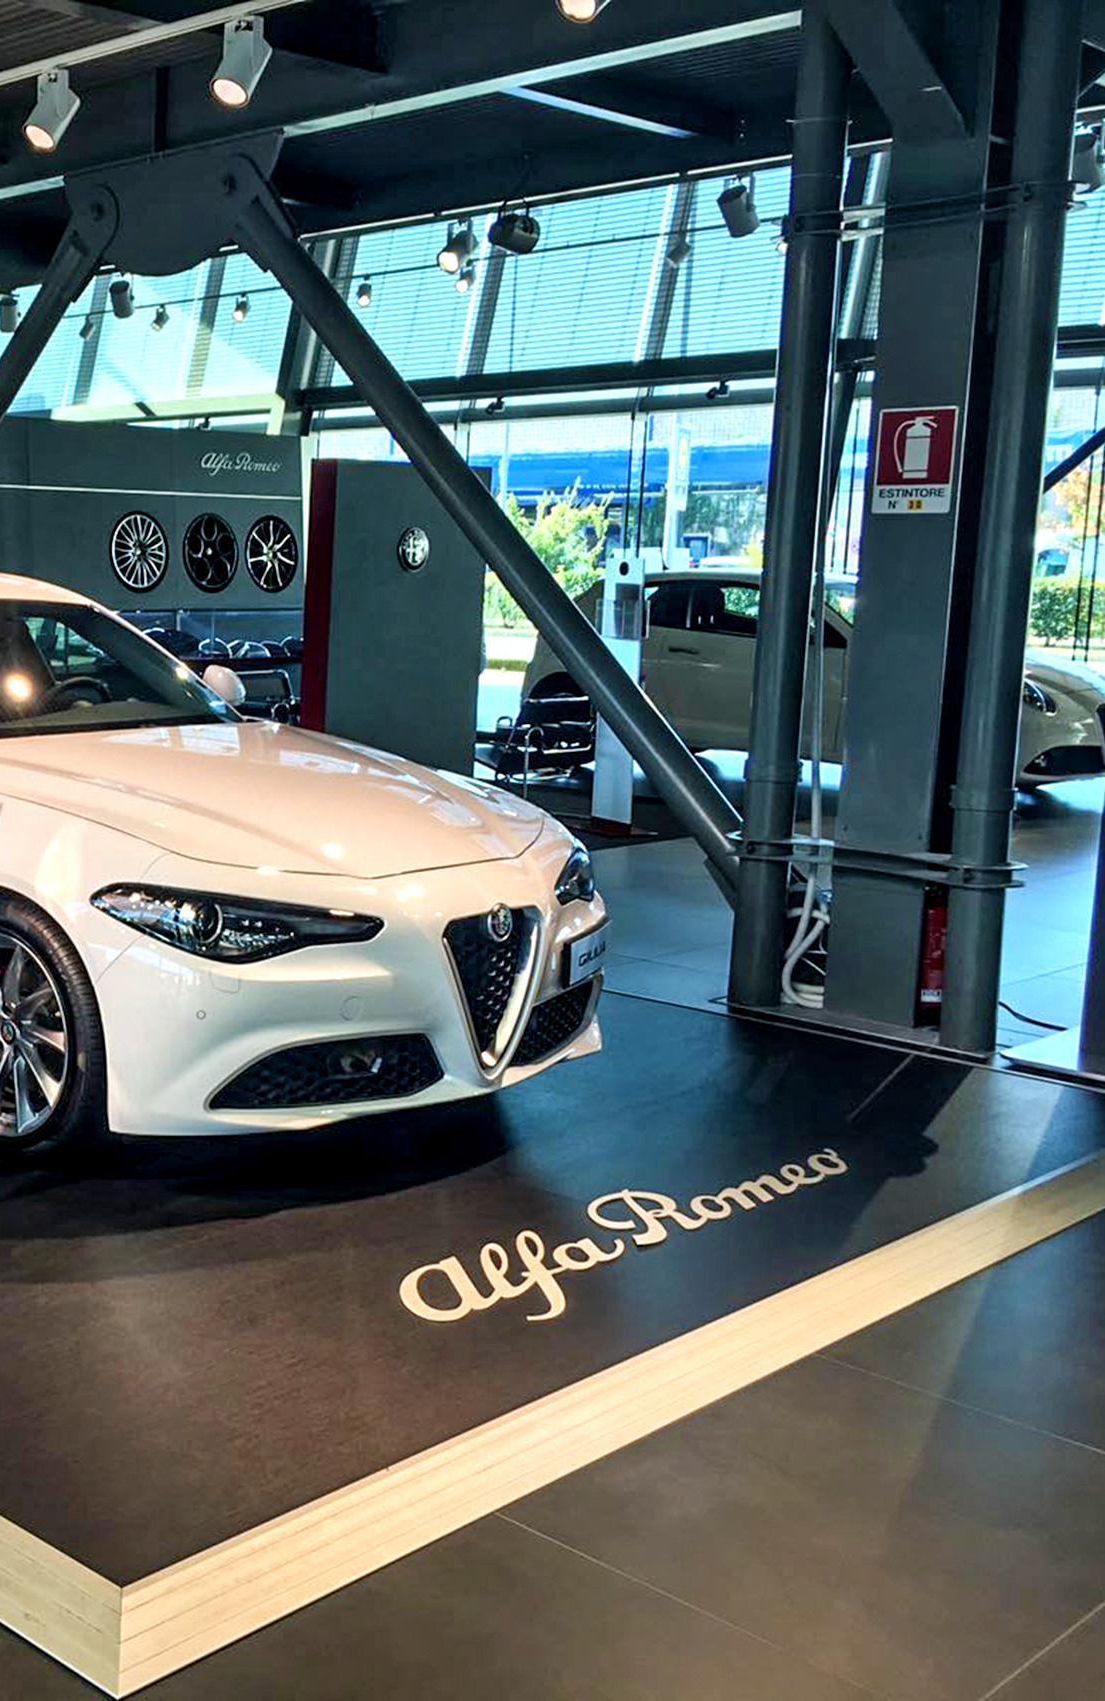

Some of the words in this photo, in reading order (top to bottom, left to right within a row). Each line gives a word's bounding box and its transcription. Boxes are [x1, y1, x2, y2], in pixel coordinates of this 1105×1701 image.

[200, 452, 233, 476] Alfa
[234, 452, 281, 472] Romeo
[878, 487, 946, 498] ESTINTORE
[397, 1228, 625, 1322] Alfa
[586, 1147, 850, 1246] Romeo
